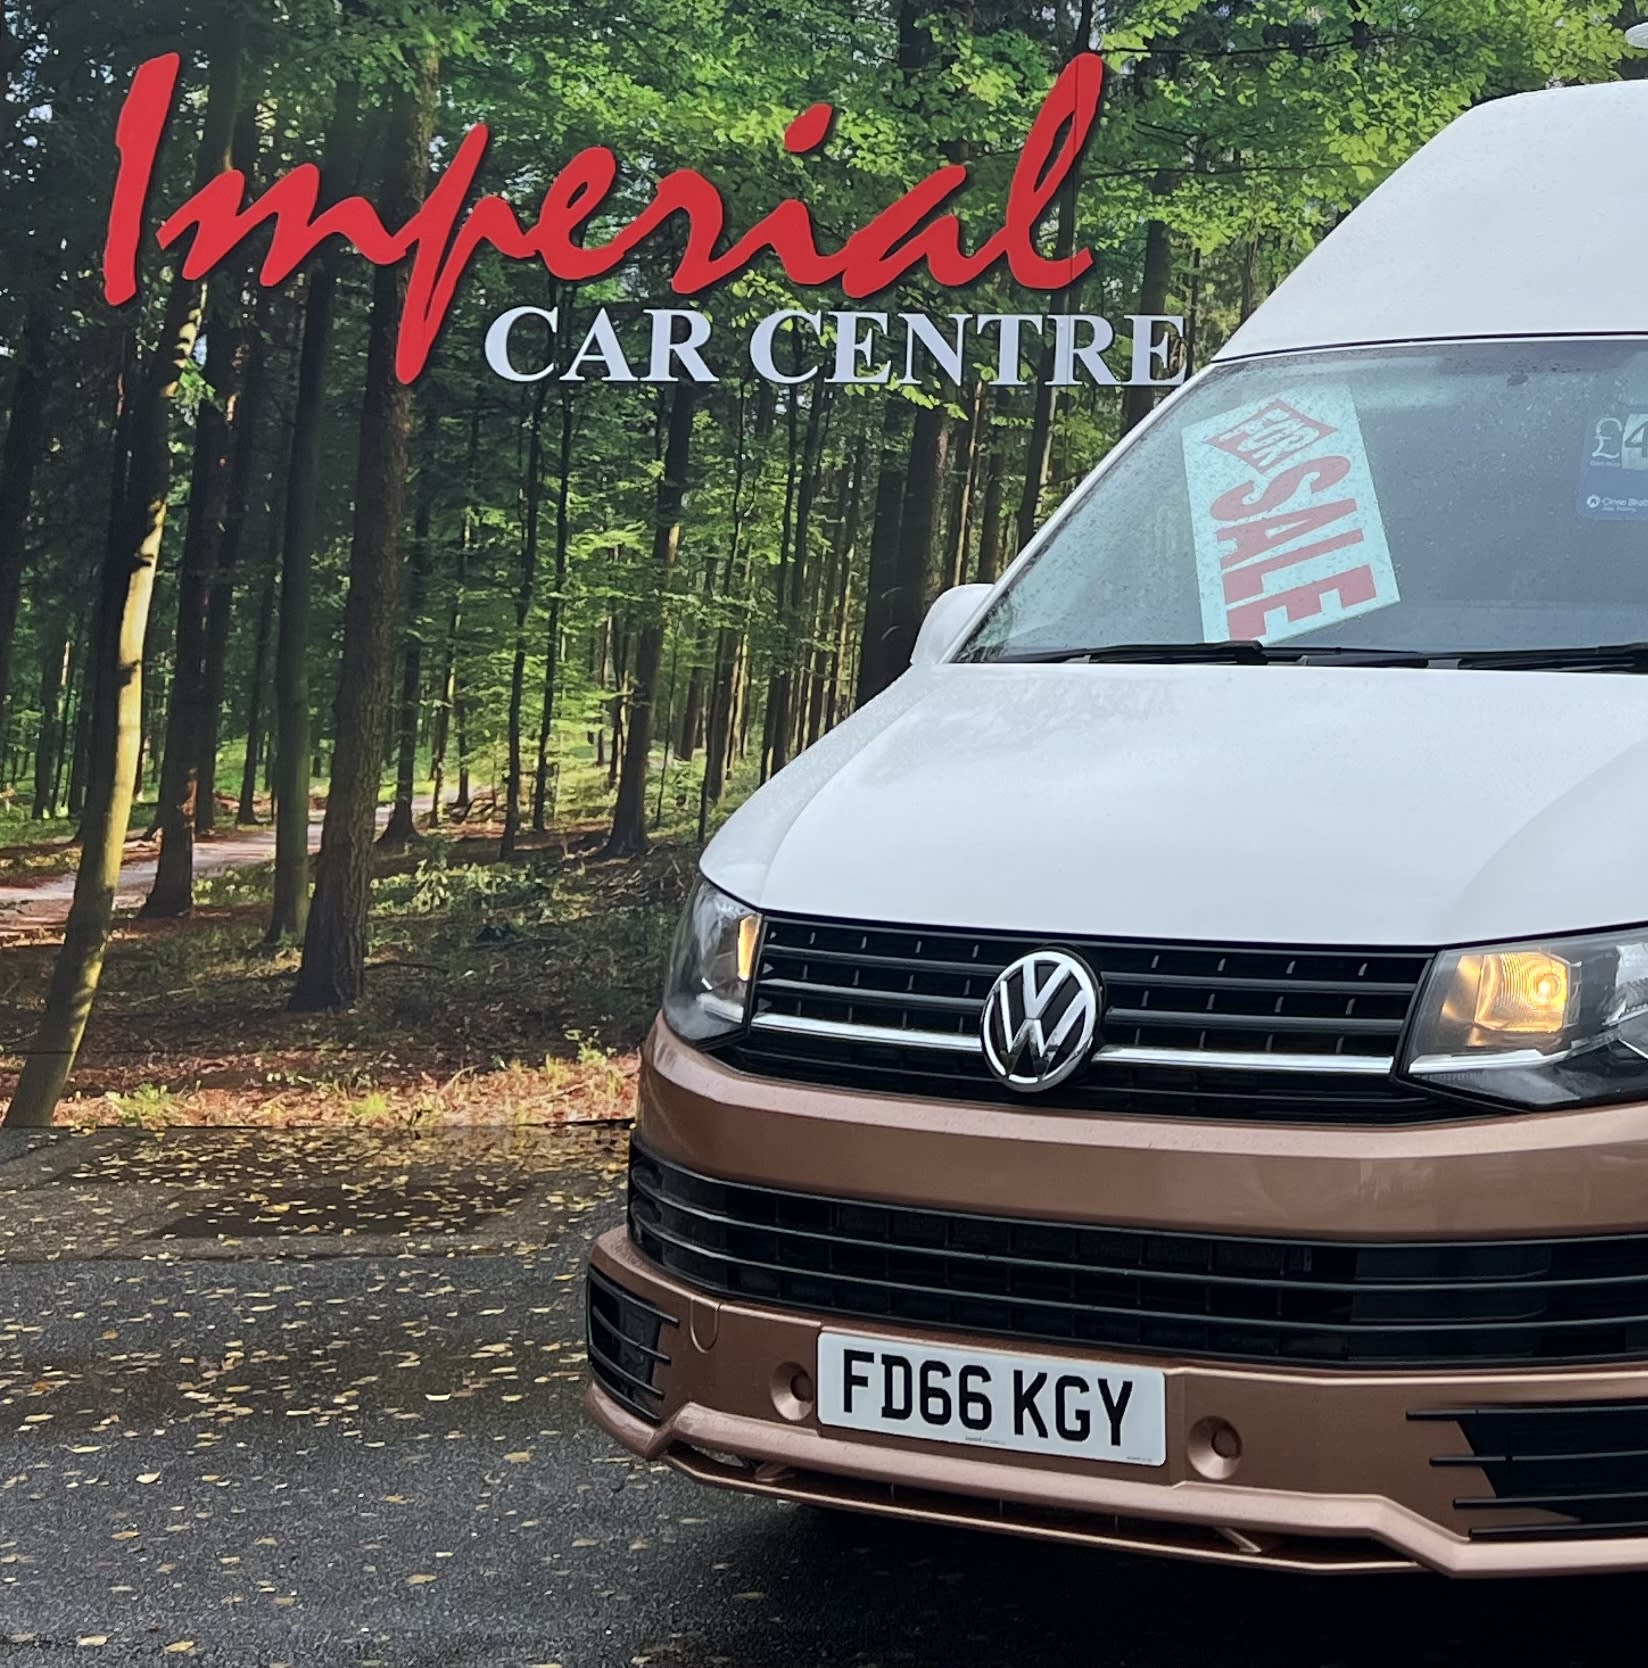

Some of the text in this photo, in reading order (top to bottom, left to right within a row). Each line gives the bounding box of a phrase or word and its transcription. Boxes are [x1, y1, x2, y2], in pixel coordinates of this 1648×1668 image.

[103, 52, 1103, 384] Imperial
[484, 306, 1188, 386] CAR CENTRE
[1210, 455, 1377, 641] SALE
[842, 1348, 1134, 1447] FD66 KGY
